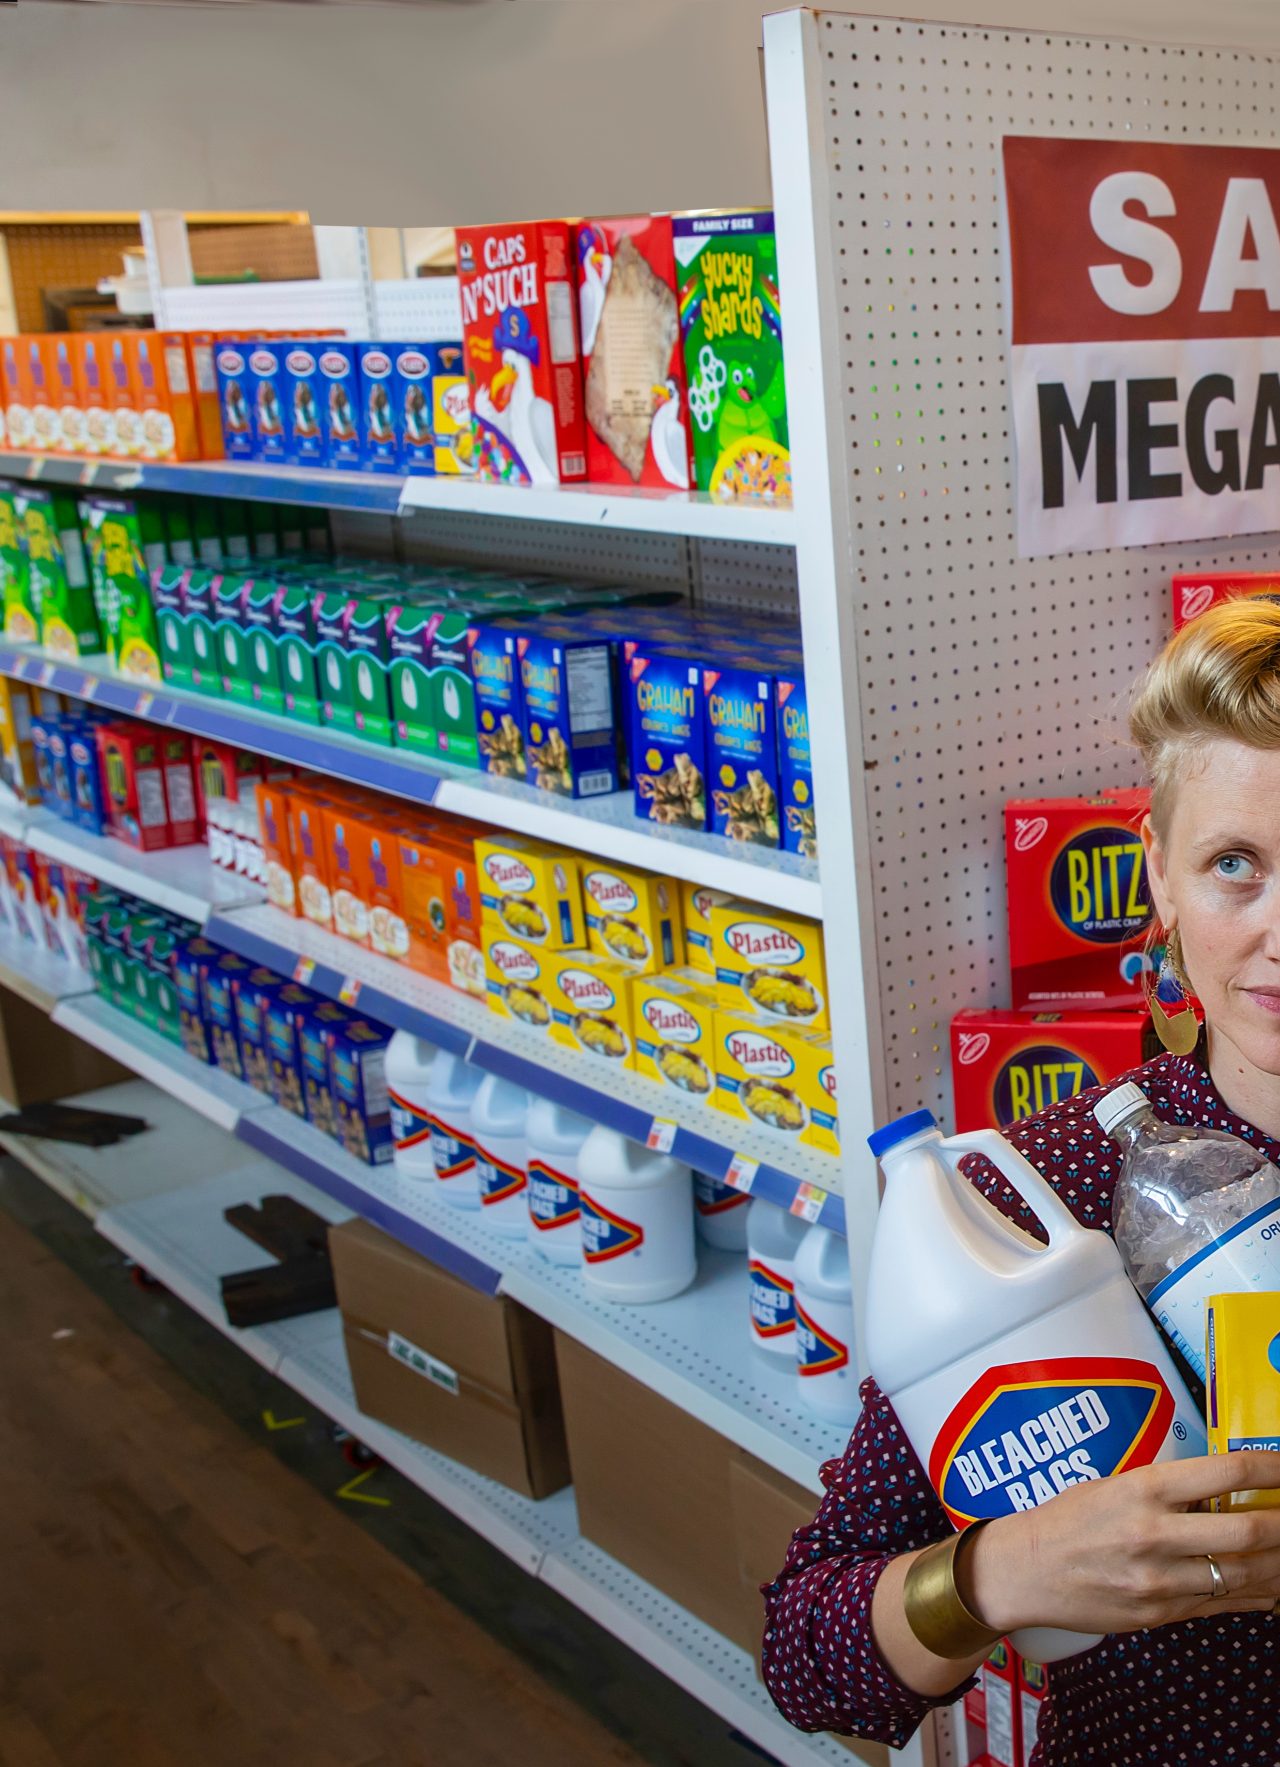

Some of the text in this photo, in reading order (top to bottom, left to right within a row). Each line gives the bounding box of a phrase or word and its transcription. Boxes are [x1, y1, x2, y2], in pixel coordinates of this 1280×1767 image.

[692, 217, 754, 232] FAMILY SIZE
[484, 233, 526, 269] CAPS
[637, 680, 694, 718] GRAHAM
[709, 694, 765, 733] GRAHAM
[783, 706, 808, 739] GRA
[489, 861, 531, 881] Plastic
[1068, 842, 1148, 923] BITZ
[590, 878, 633, 900] Plastic
[732, 929, 798, 953] Plastic
[494, 949, 536, 968] Plastic
[562, 977, 610, 1000] Plastic
[648, 1007, 696, 1030] Plastic
[732, 1039, 789, 1064] Plastic
[954, 1389, 1110, 1497] BLEACHED
